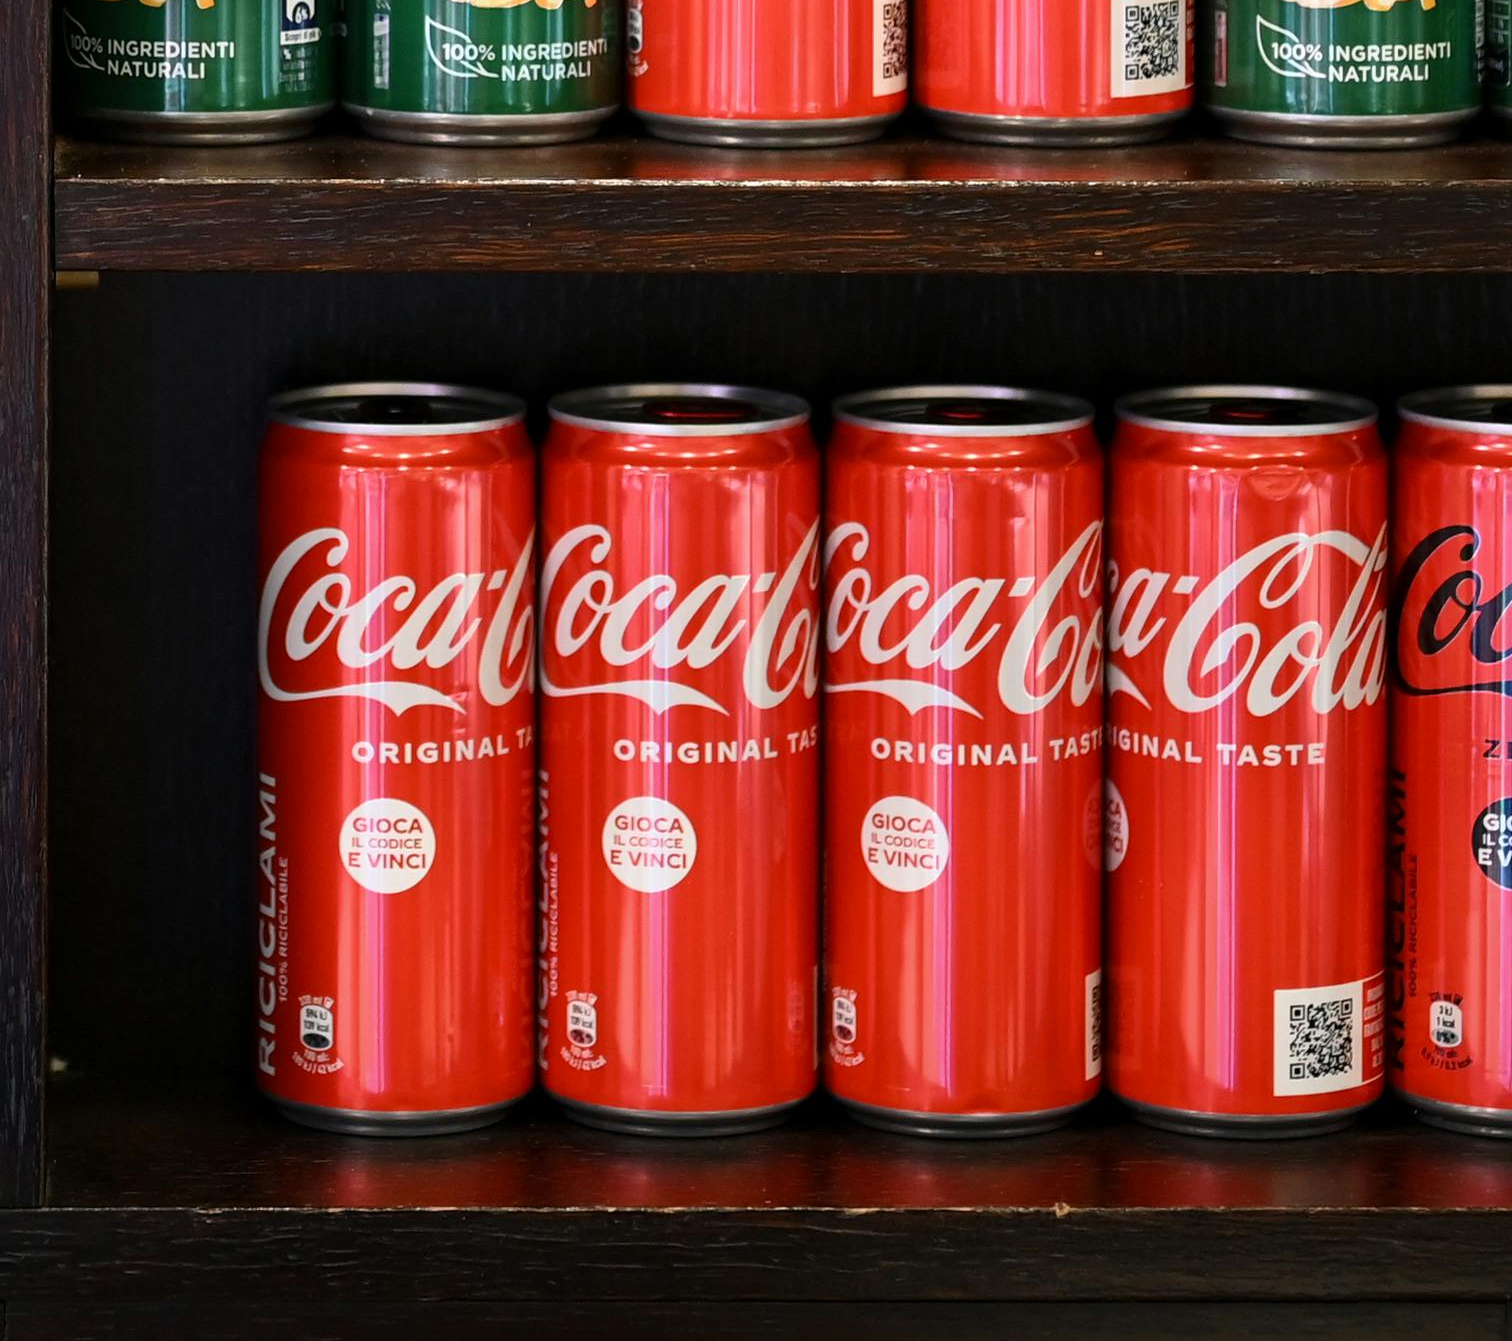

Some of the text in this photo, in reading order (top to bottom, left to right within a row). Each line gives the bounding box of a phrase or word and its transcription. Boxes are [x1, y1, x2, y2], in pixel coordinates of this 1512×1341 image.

[1272, 42, 1451, 61] 100% INGREDIENTI
[1328, 63, 1429, 83] NATURALI
[871, 738, 1038, 766] ORIGINAL
[1217, 742, 1326, 767] TASTE
